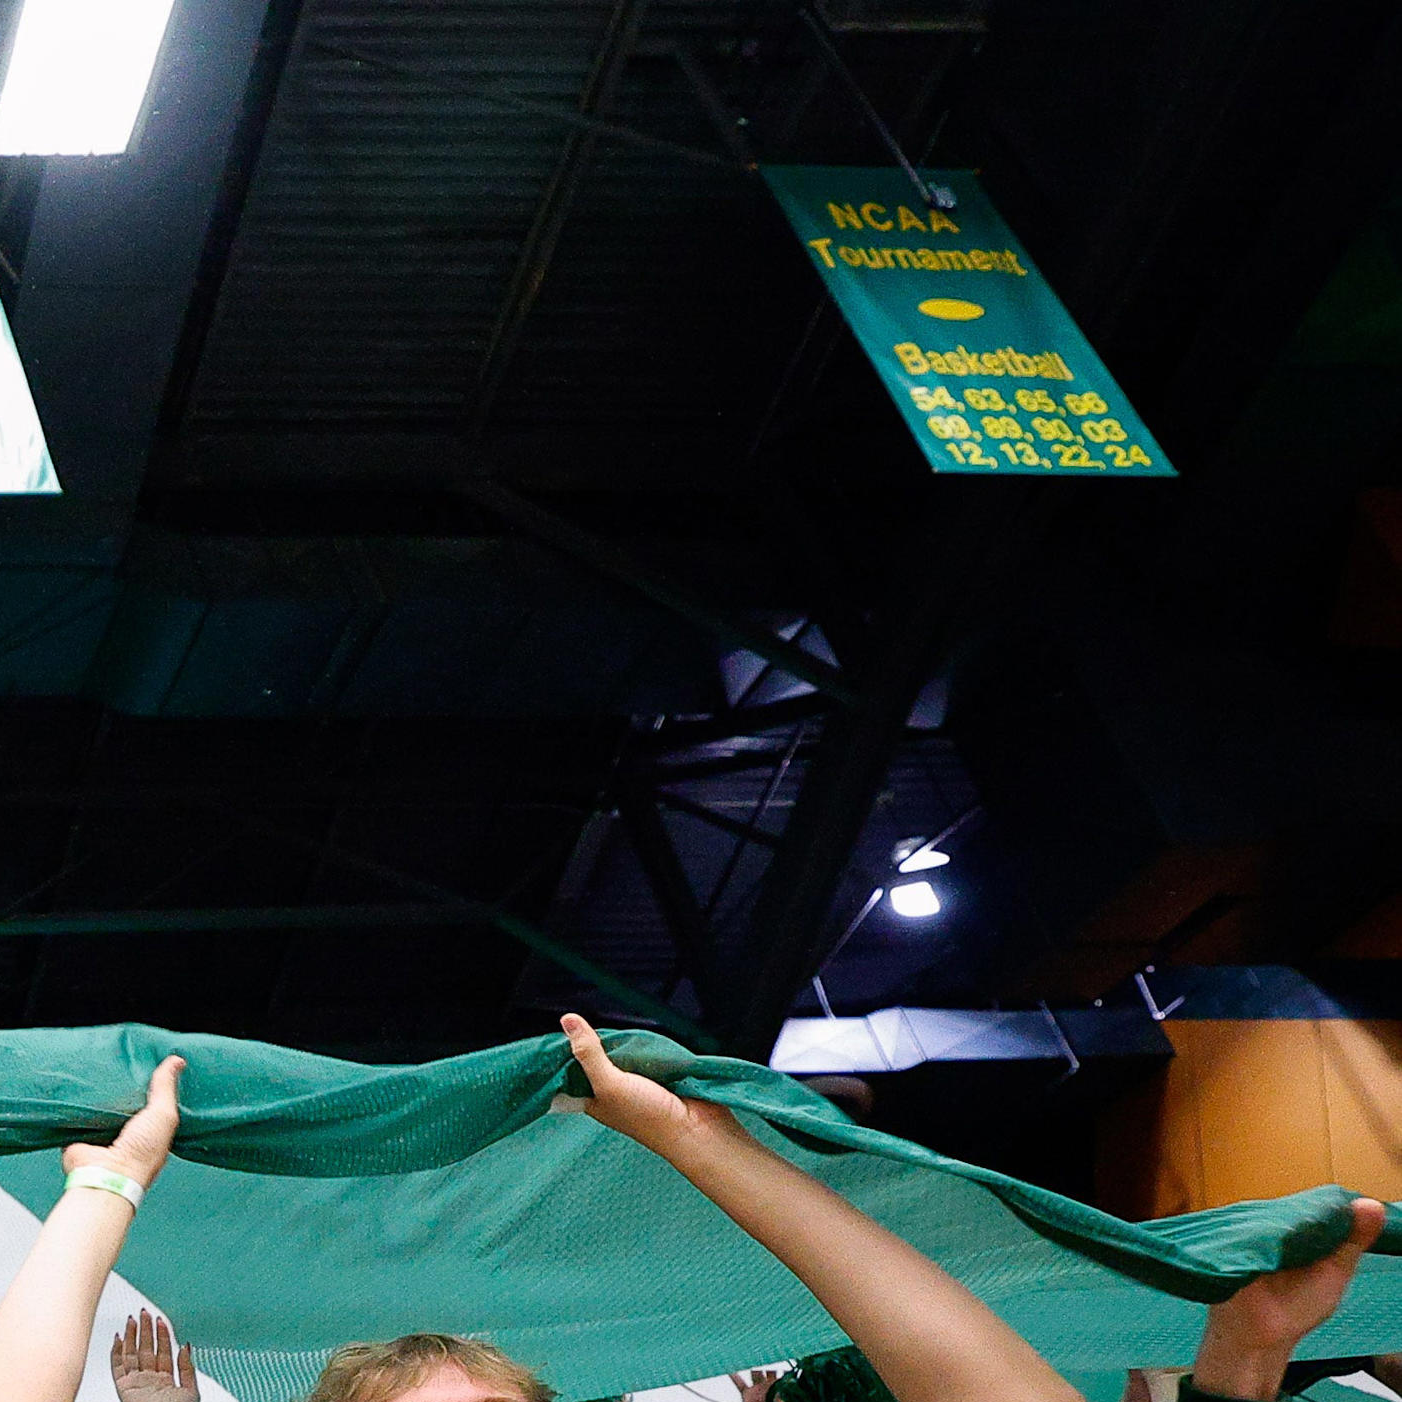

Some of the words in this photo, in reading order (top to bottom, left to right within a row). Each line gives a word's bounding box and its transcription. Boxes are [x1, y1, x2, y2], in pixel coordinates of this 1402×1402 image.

[827, 202, 960, 234] NCAA
[808, 238, 1029, 276] Tournament
[894, 342, 1074, 381] Basketball
[946, 442, 998, 469] 12,
[1000, 442, 1052, 469] 13,
[1051, 444, 1106, 470] 22,
[1104, 444, 1152, 467] 24
